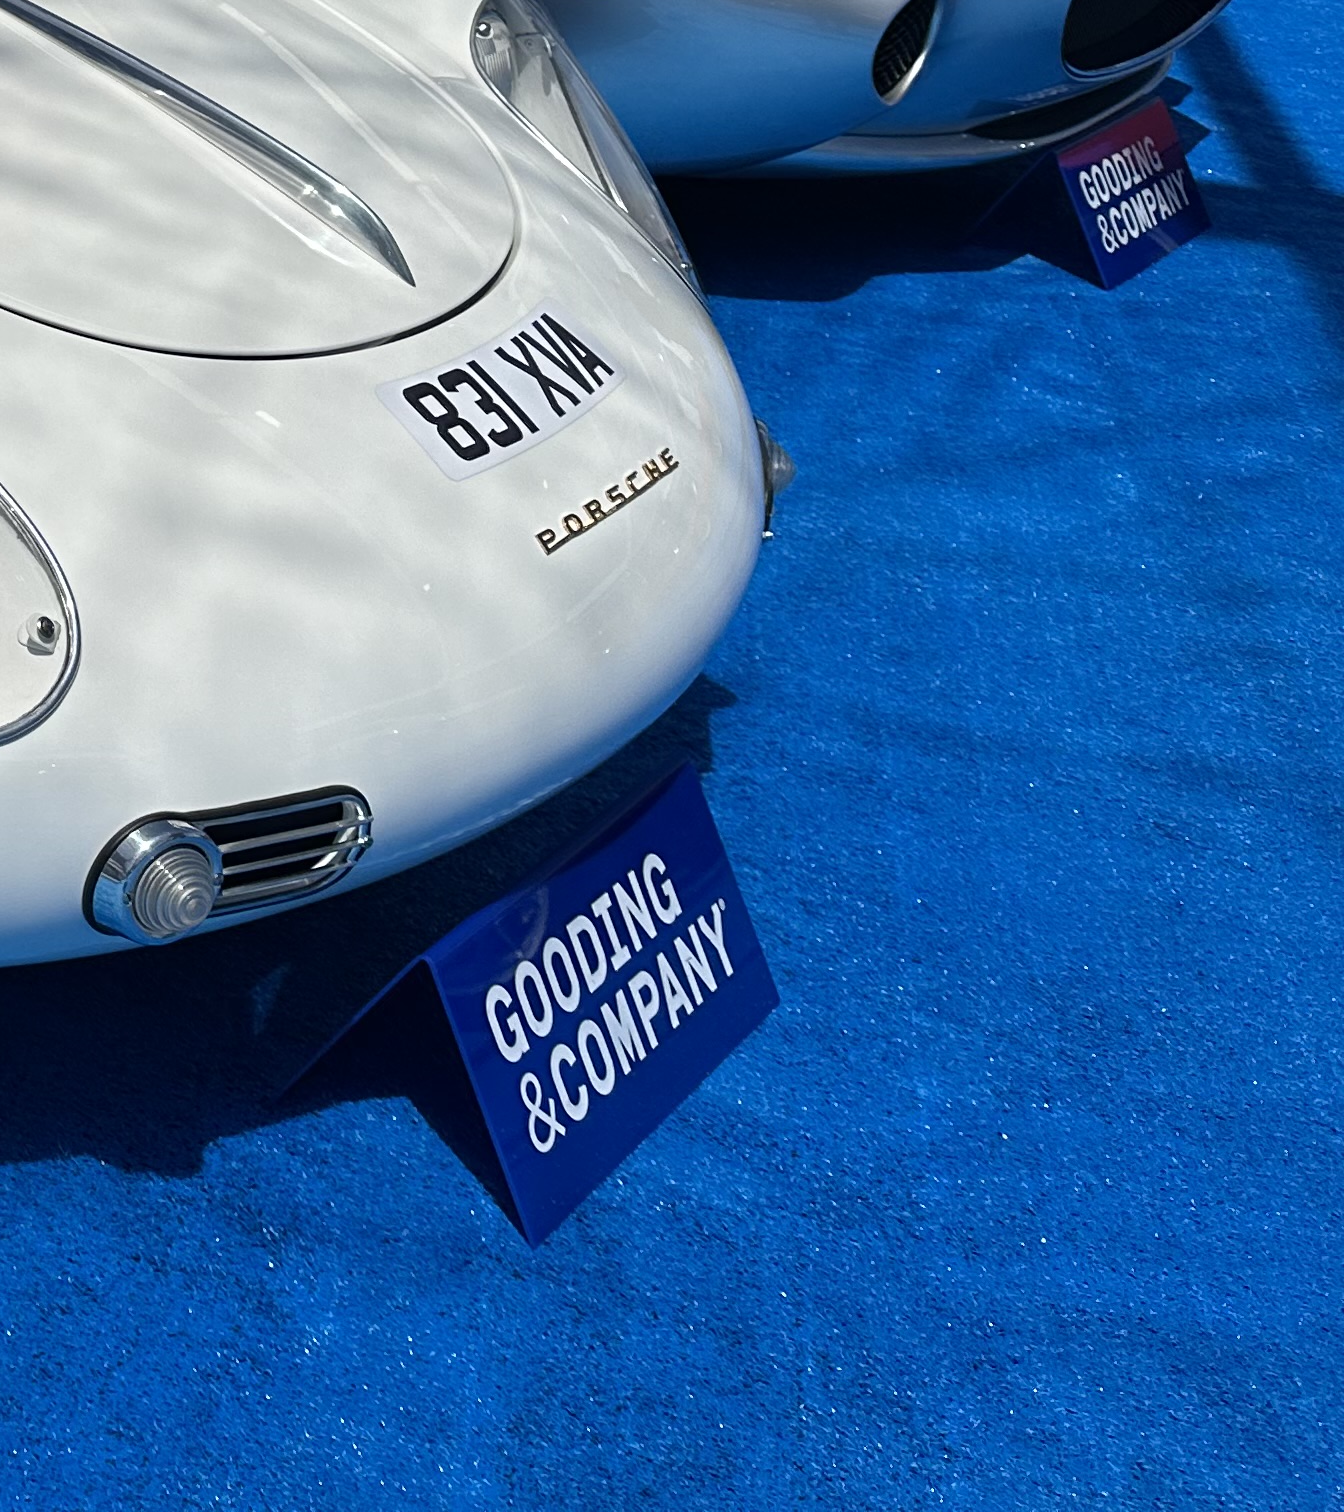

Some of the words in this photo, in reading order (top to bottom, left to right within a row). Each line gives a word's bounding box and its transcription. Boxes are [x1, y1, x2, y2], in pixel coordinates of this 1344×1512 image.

[1079, 136, 1163, 210] GOODING
[1097, 168, 1190, 254] &COMPANY
[402, 359, 540, 462] 831
[493, 312, 615, 418] XVA
[534, 447, 680, 556] PORSCHE
[484, 852, 684, 1064] GOODING
[519, 901, 735, 1154] &COMPANY
